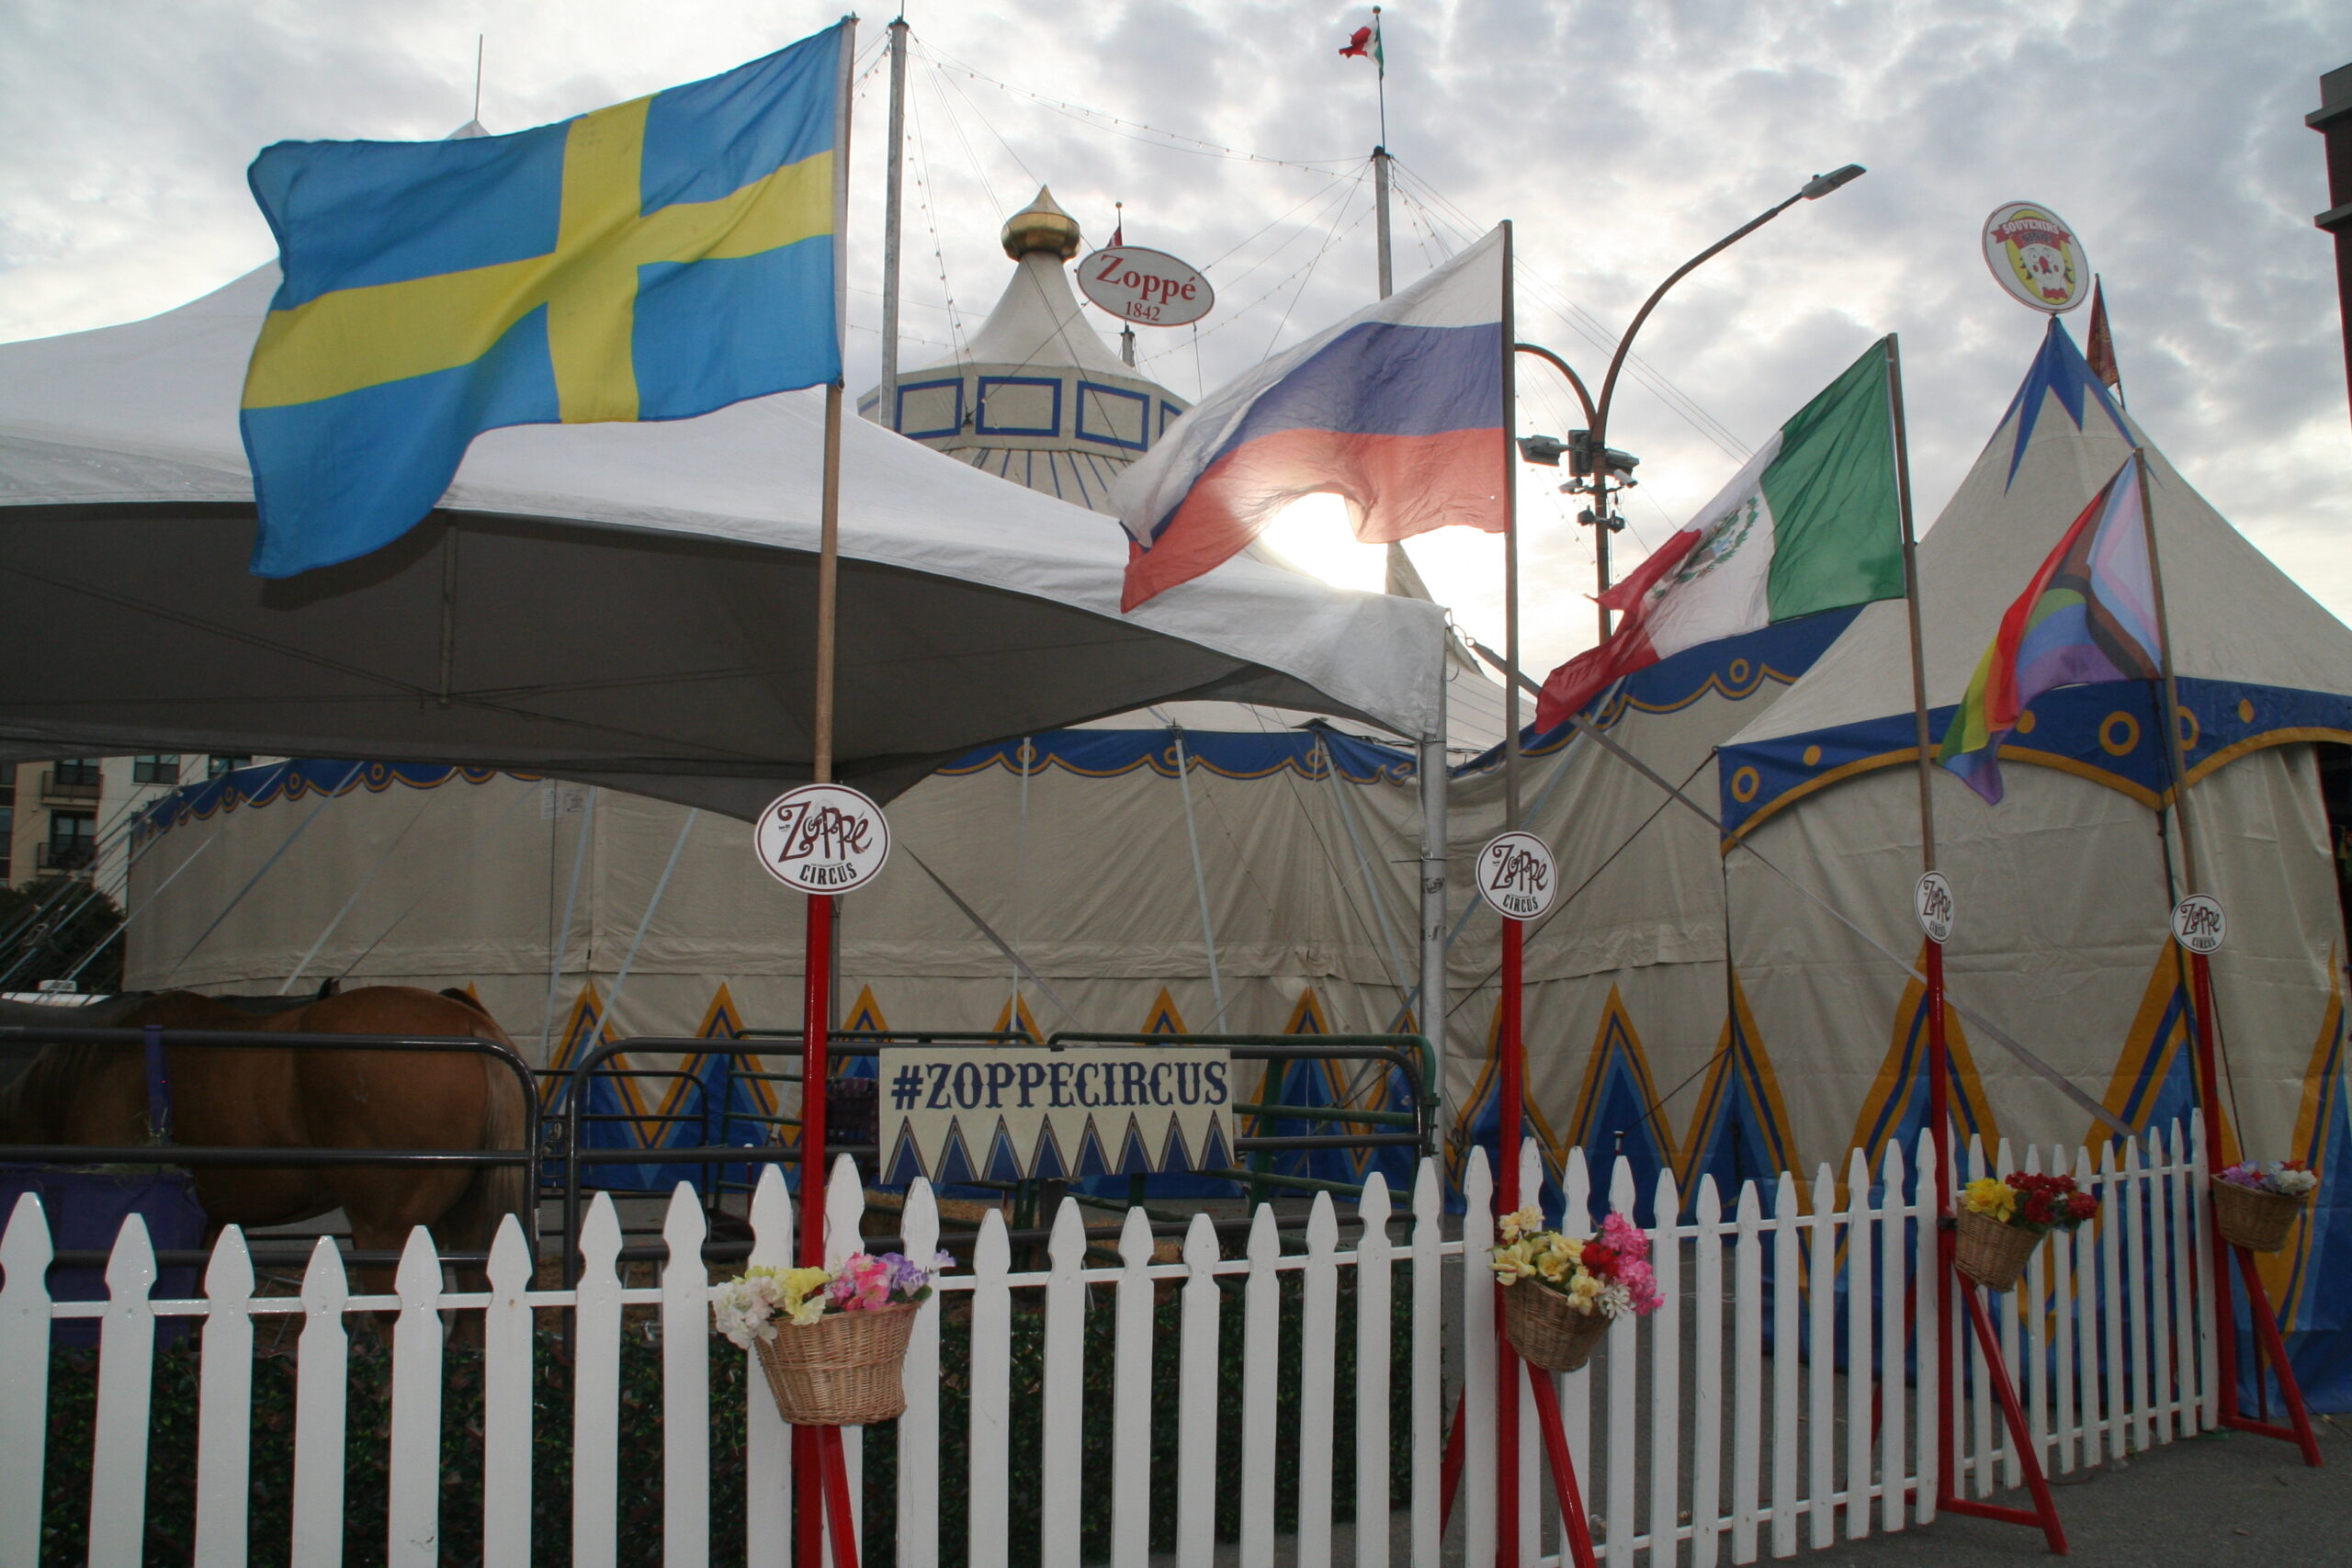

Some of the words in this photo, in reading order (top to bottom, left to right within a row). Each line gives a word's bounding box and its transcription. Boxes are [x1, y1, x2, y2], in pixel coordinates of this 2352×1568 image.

[2002, 220, 2060, 235] SOUVENIRS
[1096, 254, 1197, 306] Zoppé
[1124, 300, 1161, 321] 1842
[798, 863, 858, 886] CIRCUS
[1502, 894, 1539, 913] CIRCUS
[2191, 937, 2217, 949] CIRCUS
[890, 1060, 1228, 1111] #ZOPPECIRCUS
